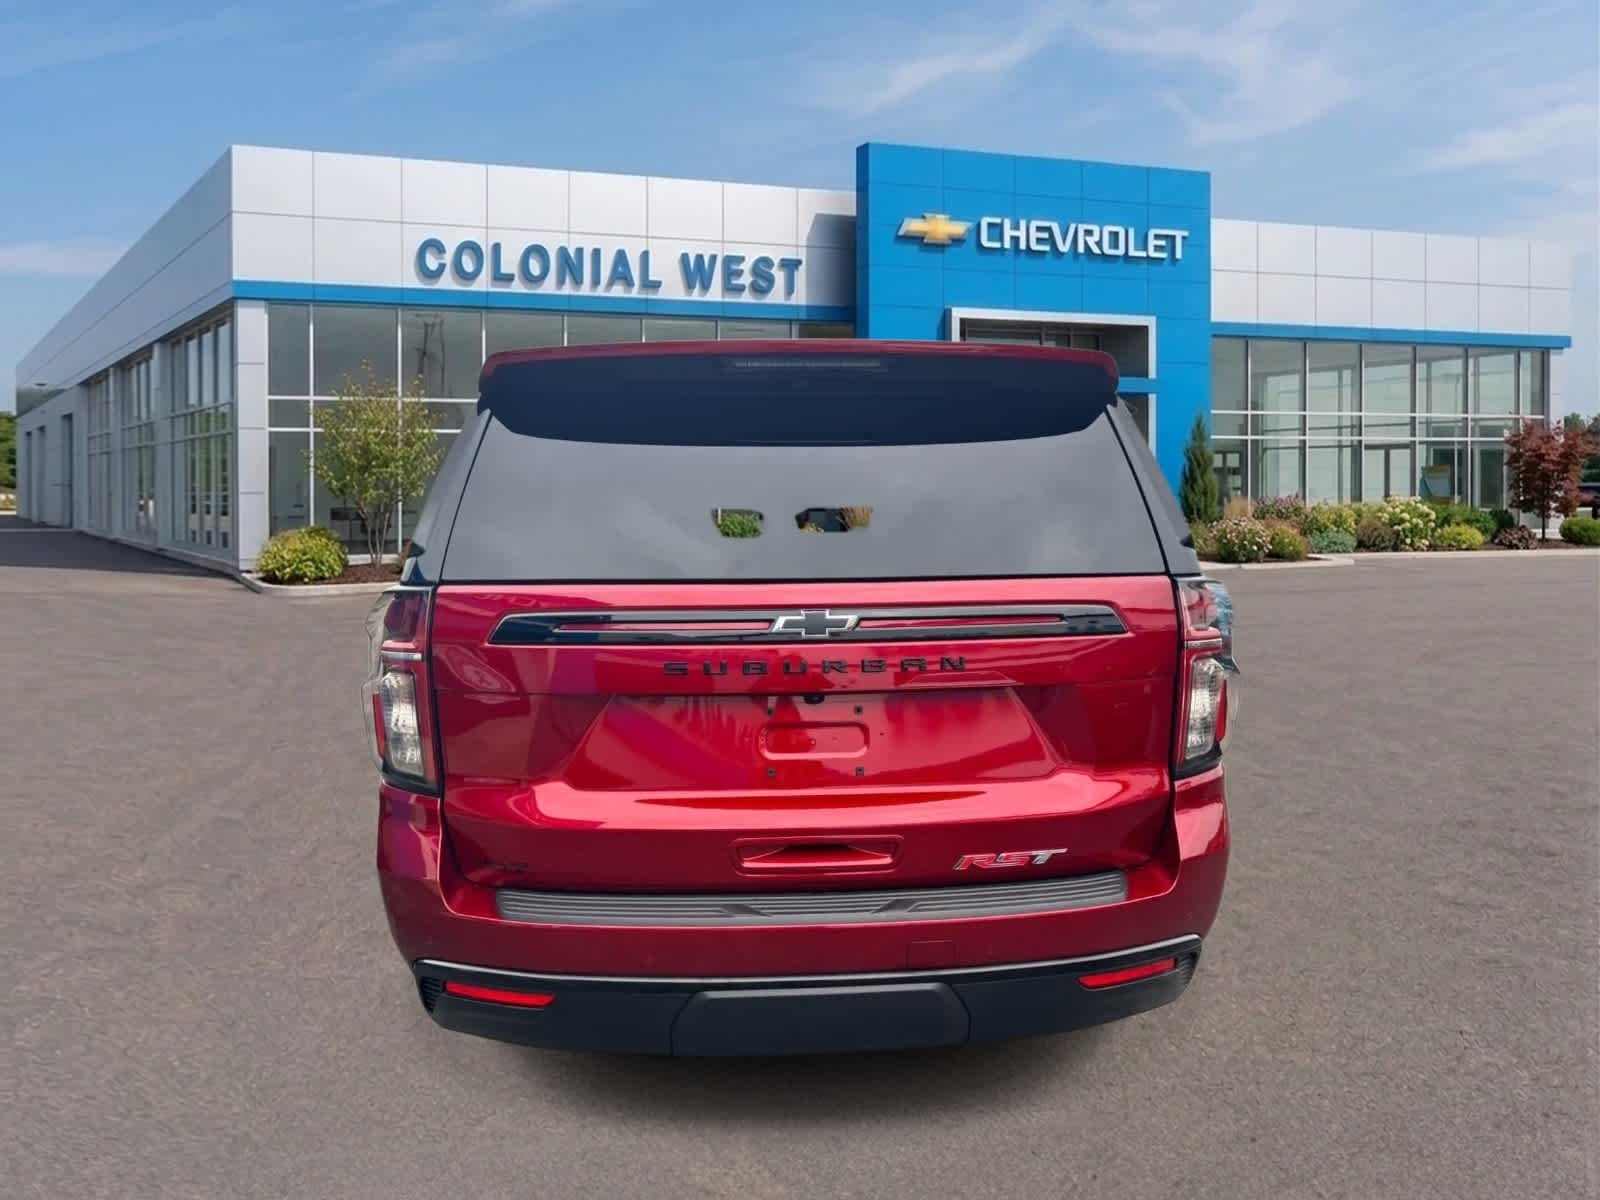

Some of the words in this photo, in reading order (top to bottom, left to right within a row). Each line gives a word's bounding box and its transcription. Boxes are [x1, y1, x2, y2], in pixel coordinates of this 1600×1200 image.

[979, 215, 1189, 261] CHEVROLET
[415, 237, 662, 289] COLONIAL
[679, 251, 803, 297] WEST
[662, 655, 967, 676] SUBURBAN
[952, 848, 1068, 870] RST
